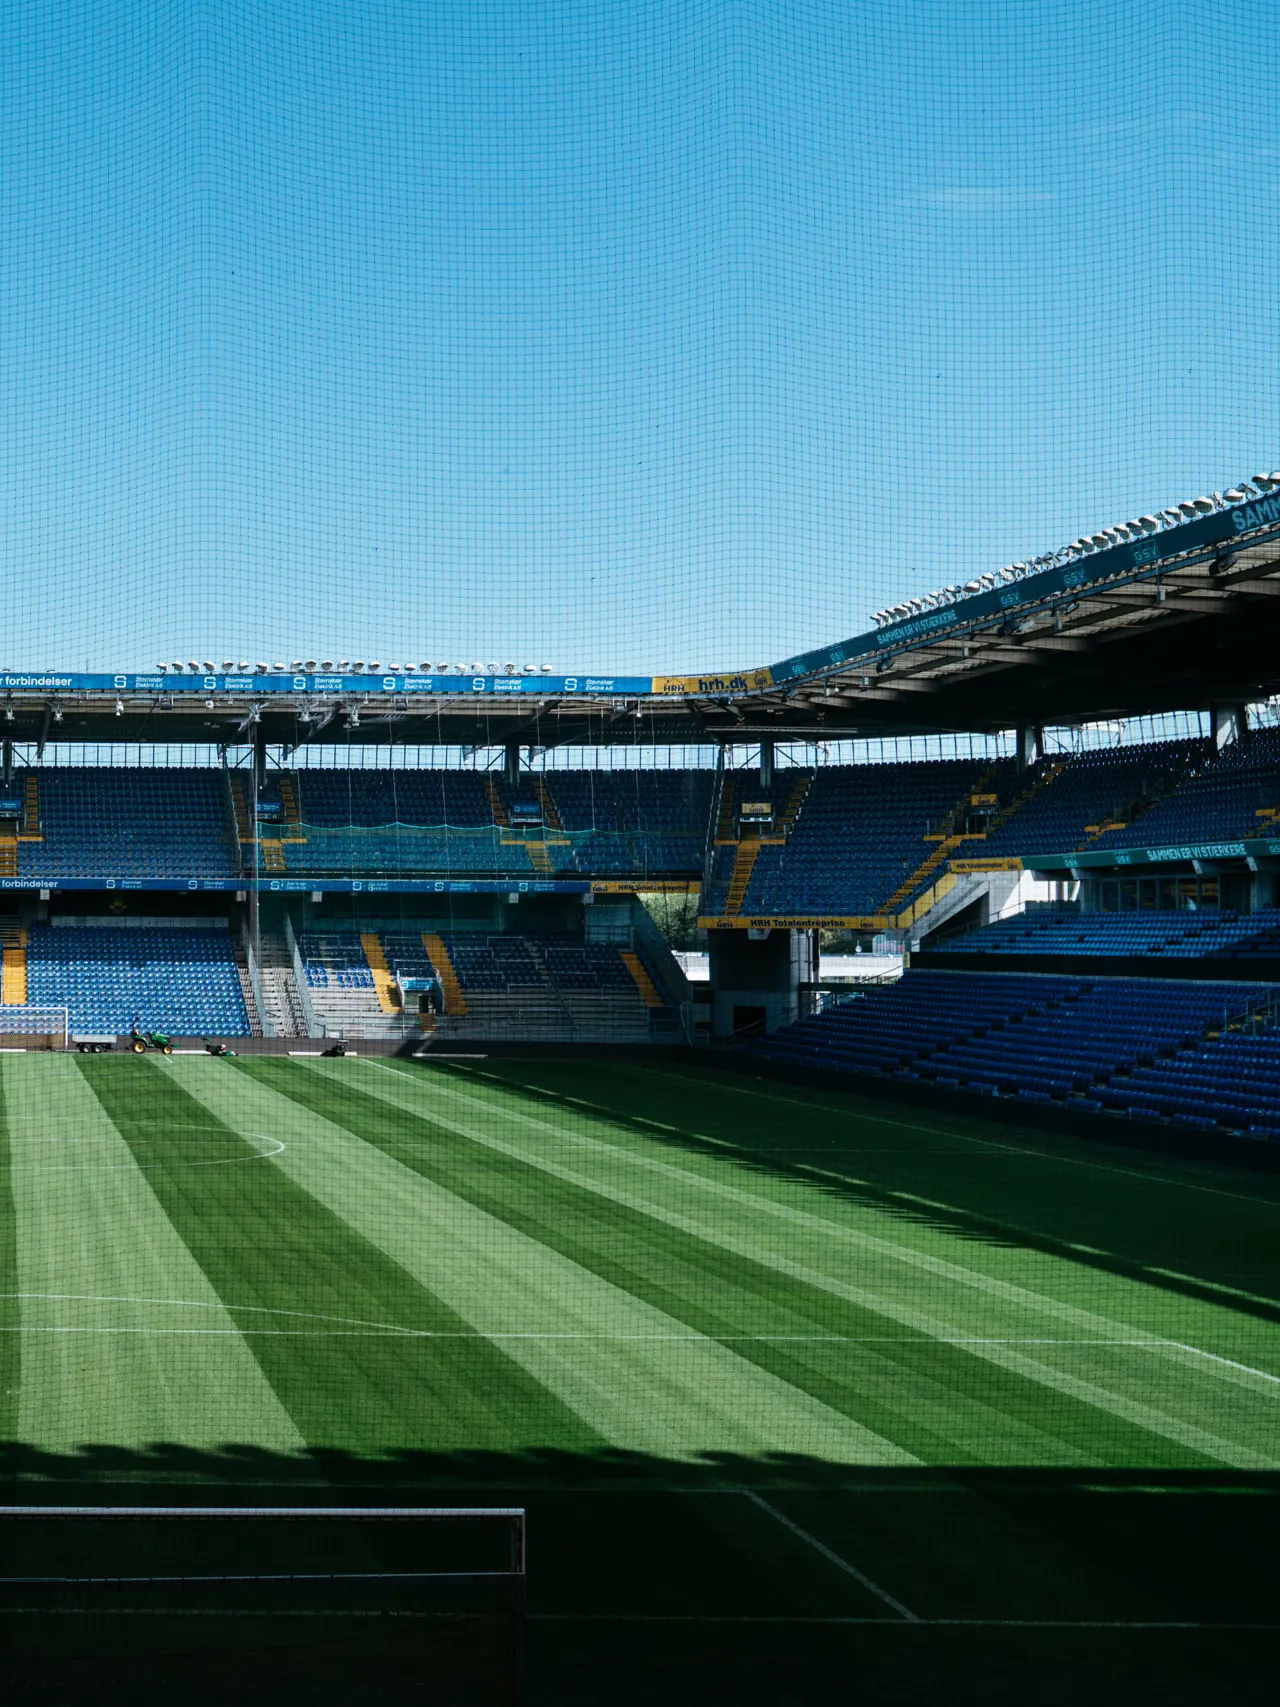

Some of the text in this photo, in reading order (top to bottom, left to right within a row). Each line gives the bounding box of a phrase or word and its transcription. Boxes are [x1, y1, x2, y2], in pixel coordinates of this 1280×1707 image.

[1134, 546, 1158, 562] GSV
[1063, 569, 1085, 585] GSV
[1000, 590, 1020, 605] GSV
[877, 628, 907, 645] SAMMEN
[904, 625, 914, 637] ER
[920, 609, 958, 630] STÆRKERE
[5, 676, 72, 686] forbindelser
[698, 677, 748, 691] hrh.dk
[1147, 843, 1248, 862] SAMMEN ER VI STÆRKERE
[1, 879, 58, 888] forbindelser
[751, 919, 845, 928] HRH Totalentreprise
